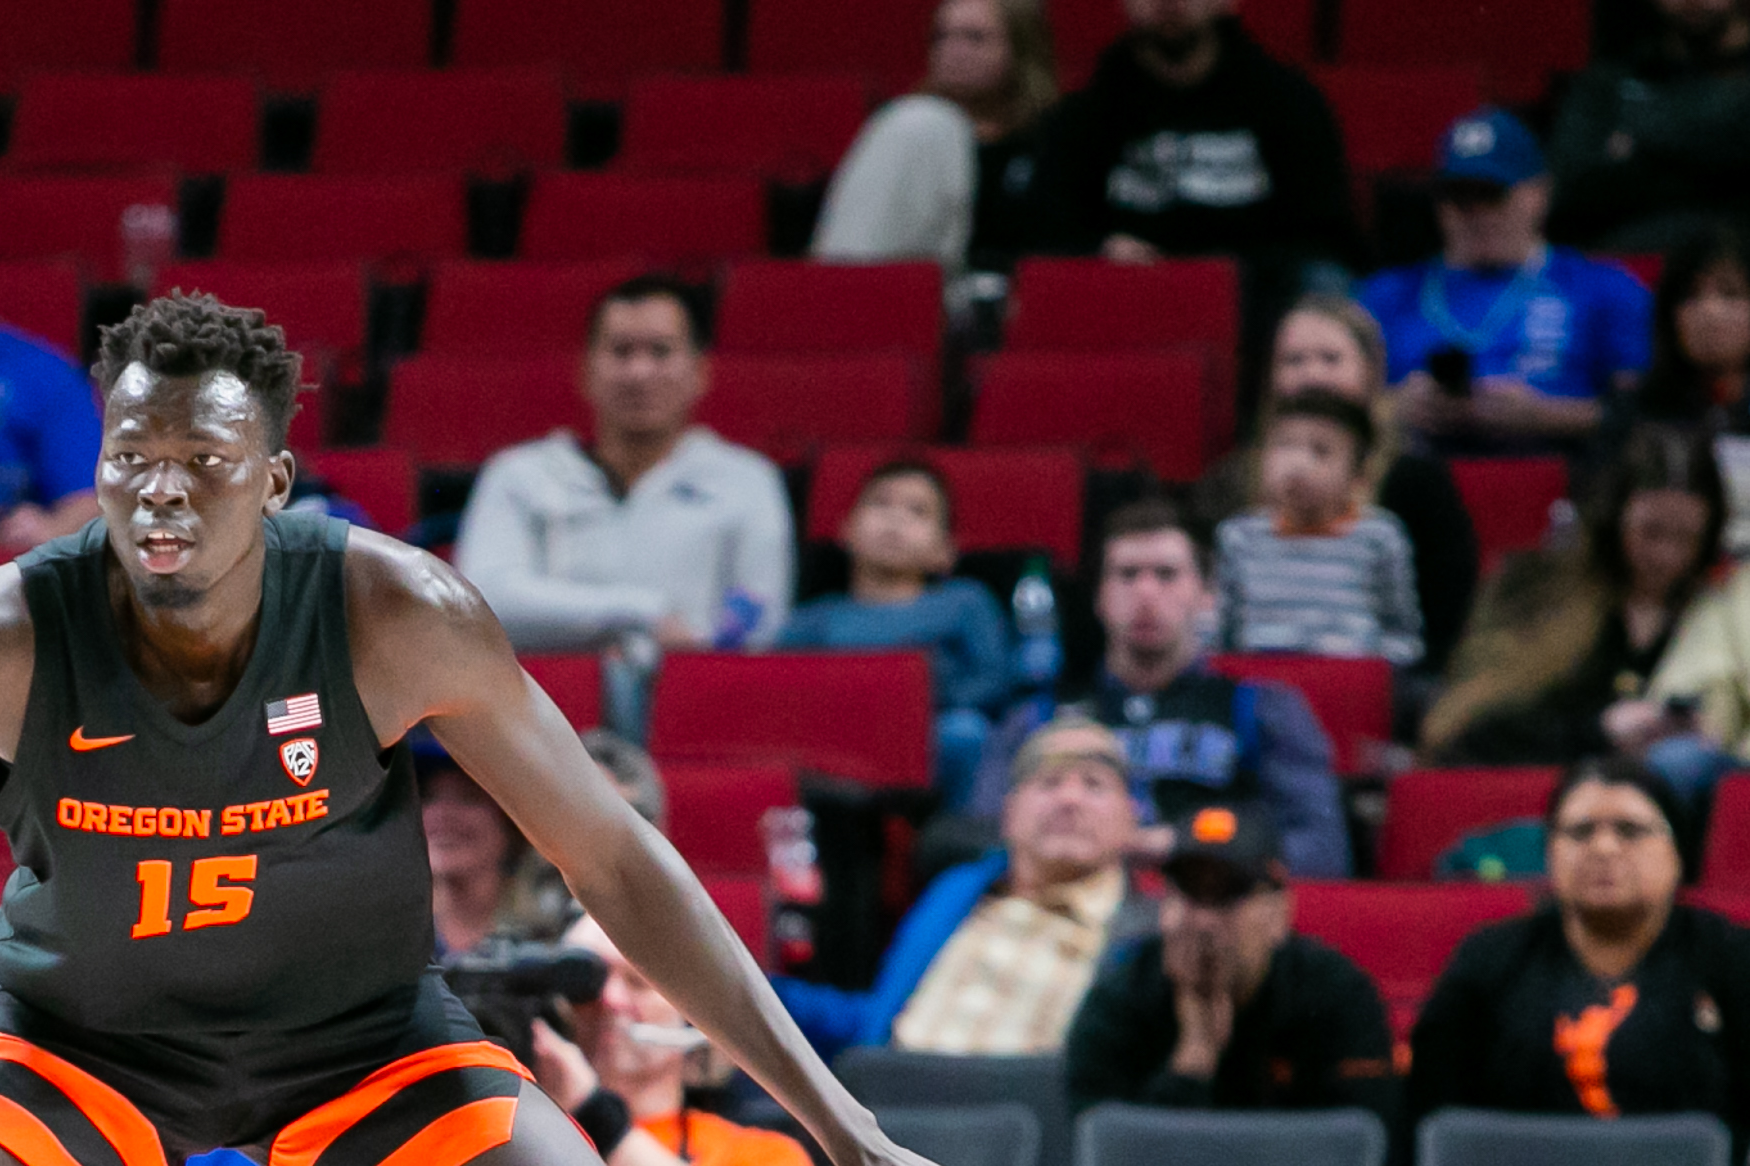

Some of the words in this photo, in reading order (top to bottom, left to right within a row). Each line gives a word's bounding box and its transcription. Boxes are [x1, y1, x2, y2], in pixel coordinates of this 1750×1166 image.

[283, 741, 316, 769] PAC
[293, 757, 312, 777] 12
[56, 797, 212, 838] OREGON
[220, 788, 330, 836] STATE
[130, 854, 258, 939] 15
